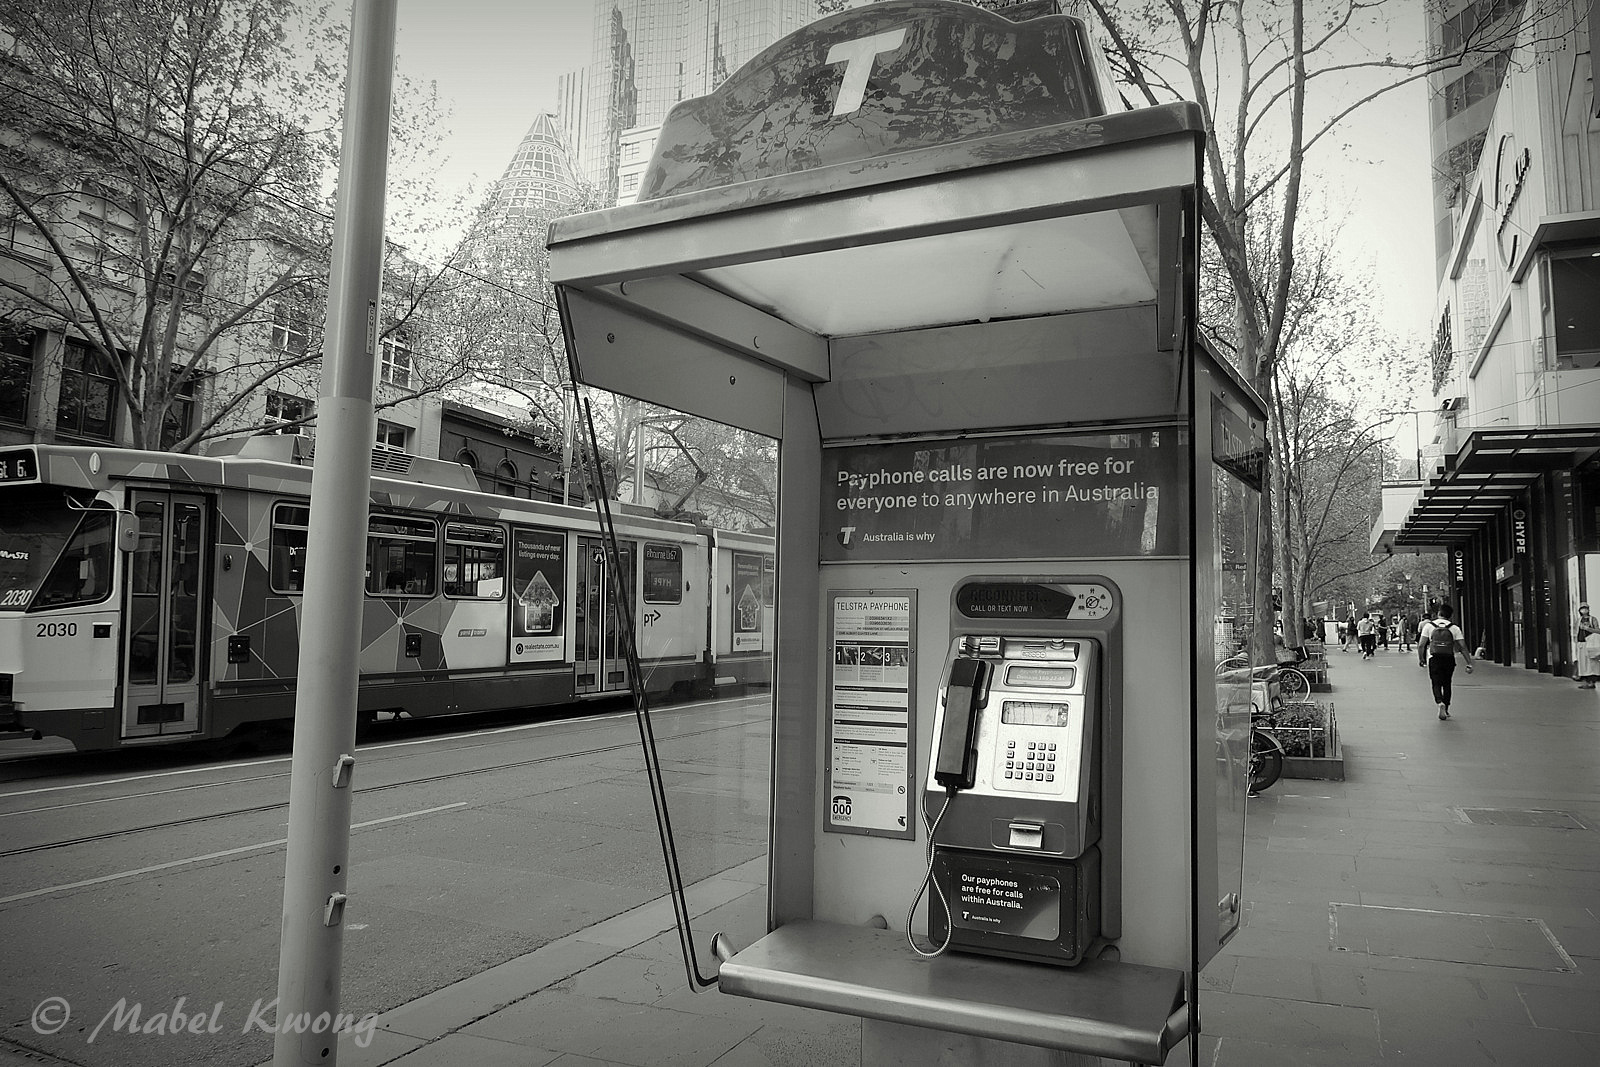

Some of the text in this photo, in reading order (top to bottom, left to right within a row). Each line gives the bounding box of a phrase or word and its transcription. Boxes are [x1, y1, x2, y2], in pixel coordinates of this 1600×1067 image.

[825, 28, 907, 117] T
[837, 456, 1135, 490] Payphone calls are now free for
[836, 481, 1158, 514] everyone to anywhere in Australia
[862, 532, 904, 543] Australia
[906, 532, 915, 542] is
[916, 532, 936, 545] why
[1515, 521, 1526, 554] HYPE
[1455, 558, 1464, 582] HYPE
[0, 589, 33, 606] 2030
[836, 601, 909, 611] TELSTRA PAYPHONE
[970, 604, 986, 612] CALL
[36, 622, 77, 638] 2030
[860, 651, 866, 662] 2
[884, 652, 891, 662] 3
[832, 803, 852, 815] 000
[961, 874, 1018, 887] Our payphones
[961, 885, 1024, 899] are free for calls
[961, 895, 1023, 909] within Australia.
